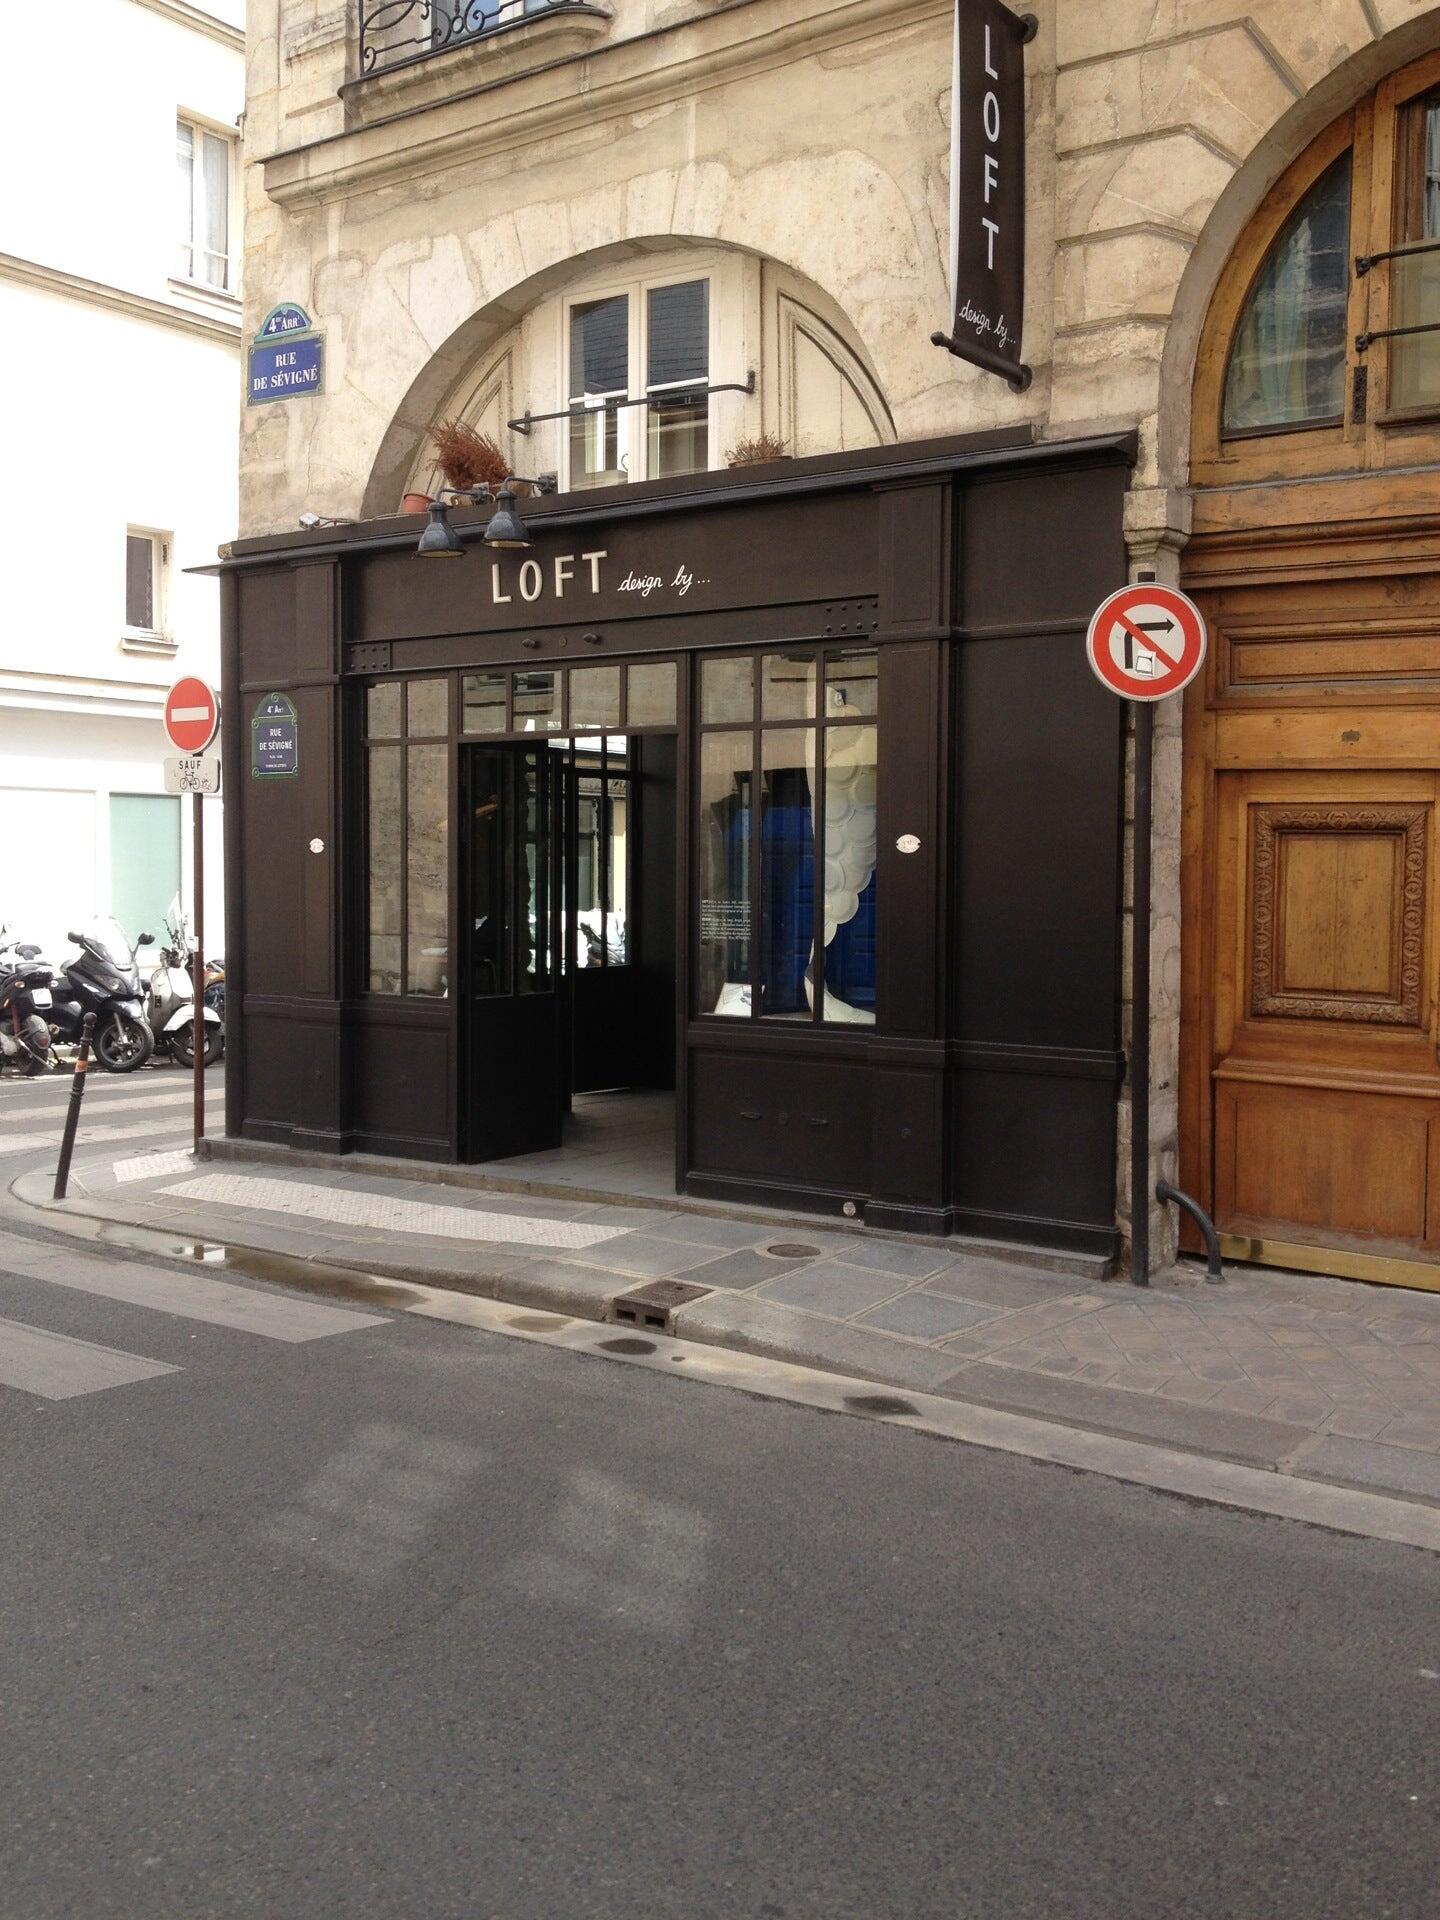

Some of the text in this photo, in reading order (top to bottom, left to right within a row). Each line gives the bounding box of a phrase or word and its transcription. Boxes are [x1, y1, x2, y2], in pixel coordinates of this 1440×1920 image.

[983, 24, 1000, 270] LOFT
[959, 299, 991, 335] design
[275, 351, 297, 368] RUE
[253, 364, 318, 391] DE SÉVIGNÉ
[491, 550, 608, 604] LOFT
[617, 571, 663, 597] design
[269, 728, 282, 737] RUE
[259, 740, 293, 751] DE SÉVIGNÉ
[178, 760, 202, 770] SAUF
